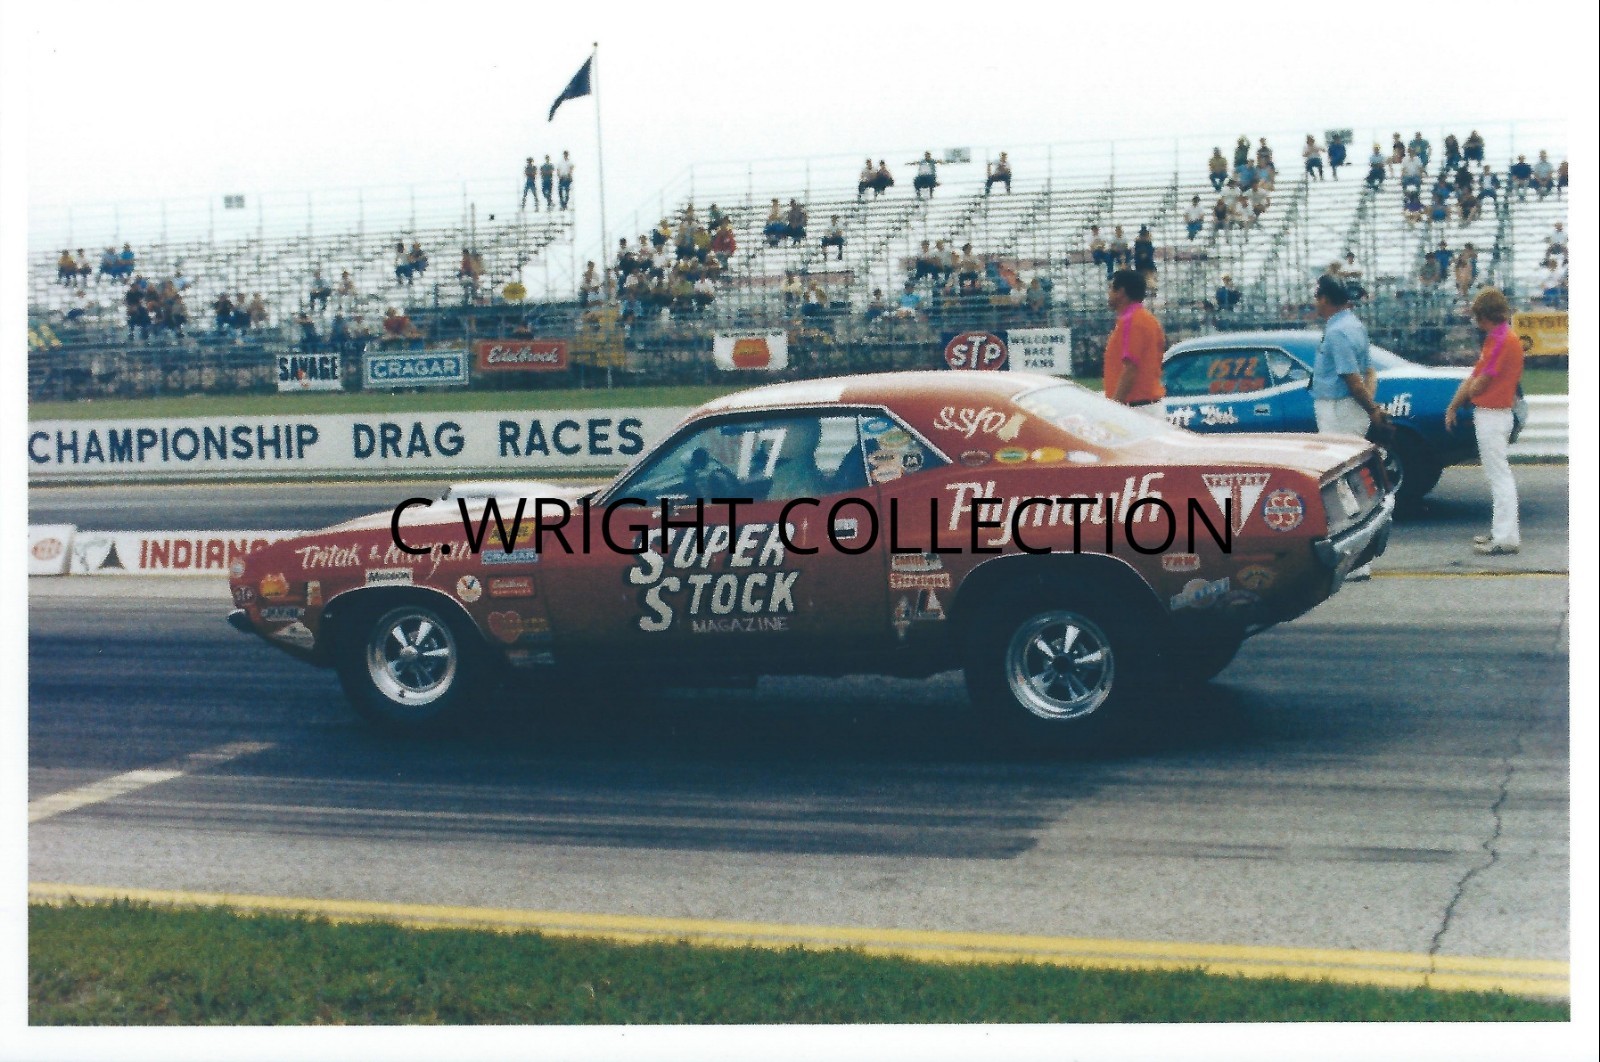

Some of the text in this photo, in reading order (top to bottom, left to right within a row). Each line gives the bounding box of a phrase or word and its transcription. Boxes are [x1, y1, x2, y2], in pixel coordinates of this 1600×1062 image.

[951, 335, 1001, 369] STP
[1011, 335, 1065, 345] WELCOME
[279, 356, 338, 381] SAVAGE
[373, 361, 456, 378] CRAGAR
[28, 418, 645, 464] CHAMPIONSHIP DRAG RACES
[736, 428, 787, 480] 17
[946, 472, 1165, 546] Plymouth
[294, 544, 361, 570] Tritak
[629, 522, 796, 585] SUPER
[1165, 555, 1196, 567] TRW
[890, 573, 950, 588] Firestone
[639, 571, 800, 632] STOCK
[691, 616, 789, 633] MAGAZINE
